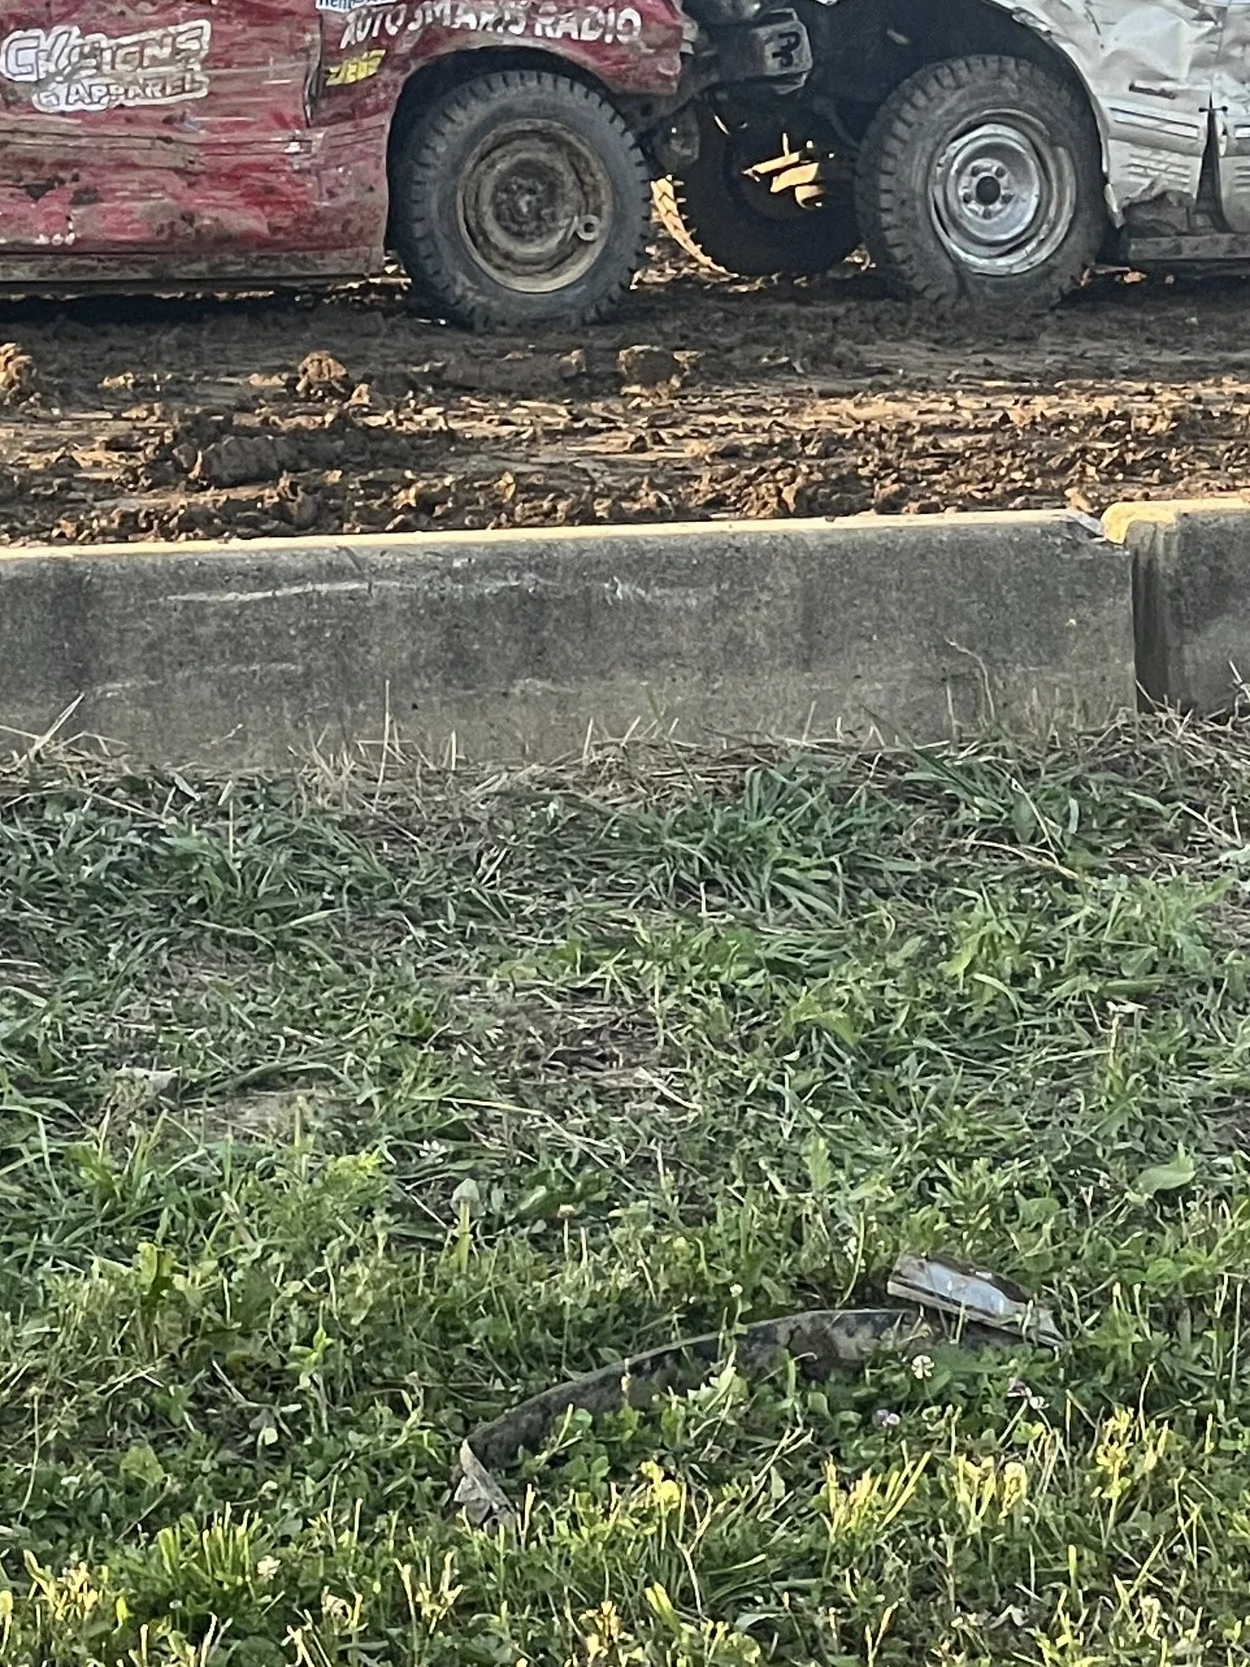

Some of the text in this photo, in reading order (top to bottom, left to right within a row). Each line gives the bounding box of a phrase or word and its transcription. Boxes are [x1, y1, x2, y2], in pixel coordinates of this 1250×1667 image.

[340, 3, 408, 50] AUTO
[533, 1, 642, 45] RADIO
[67, 72, 205, 104] APPAREL
